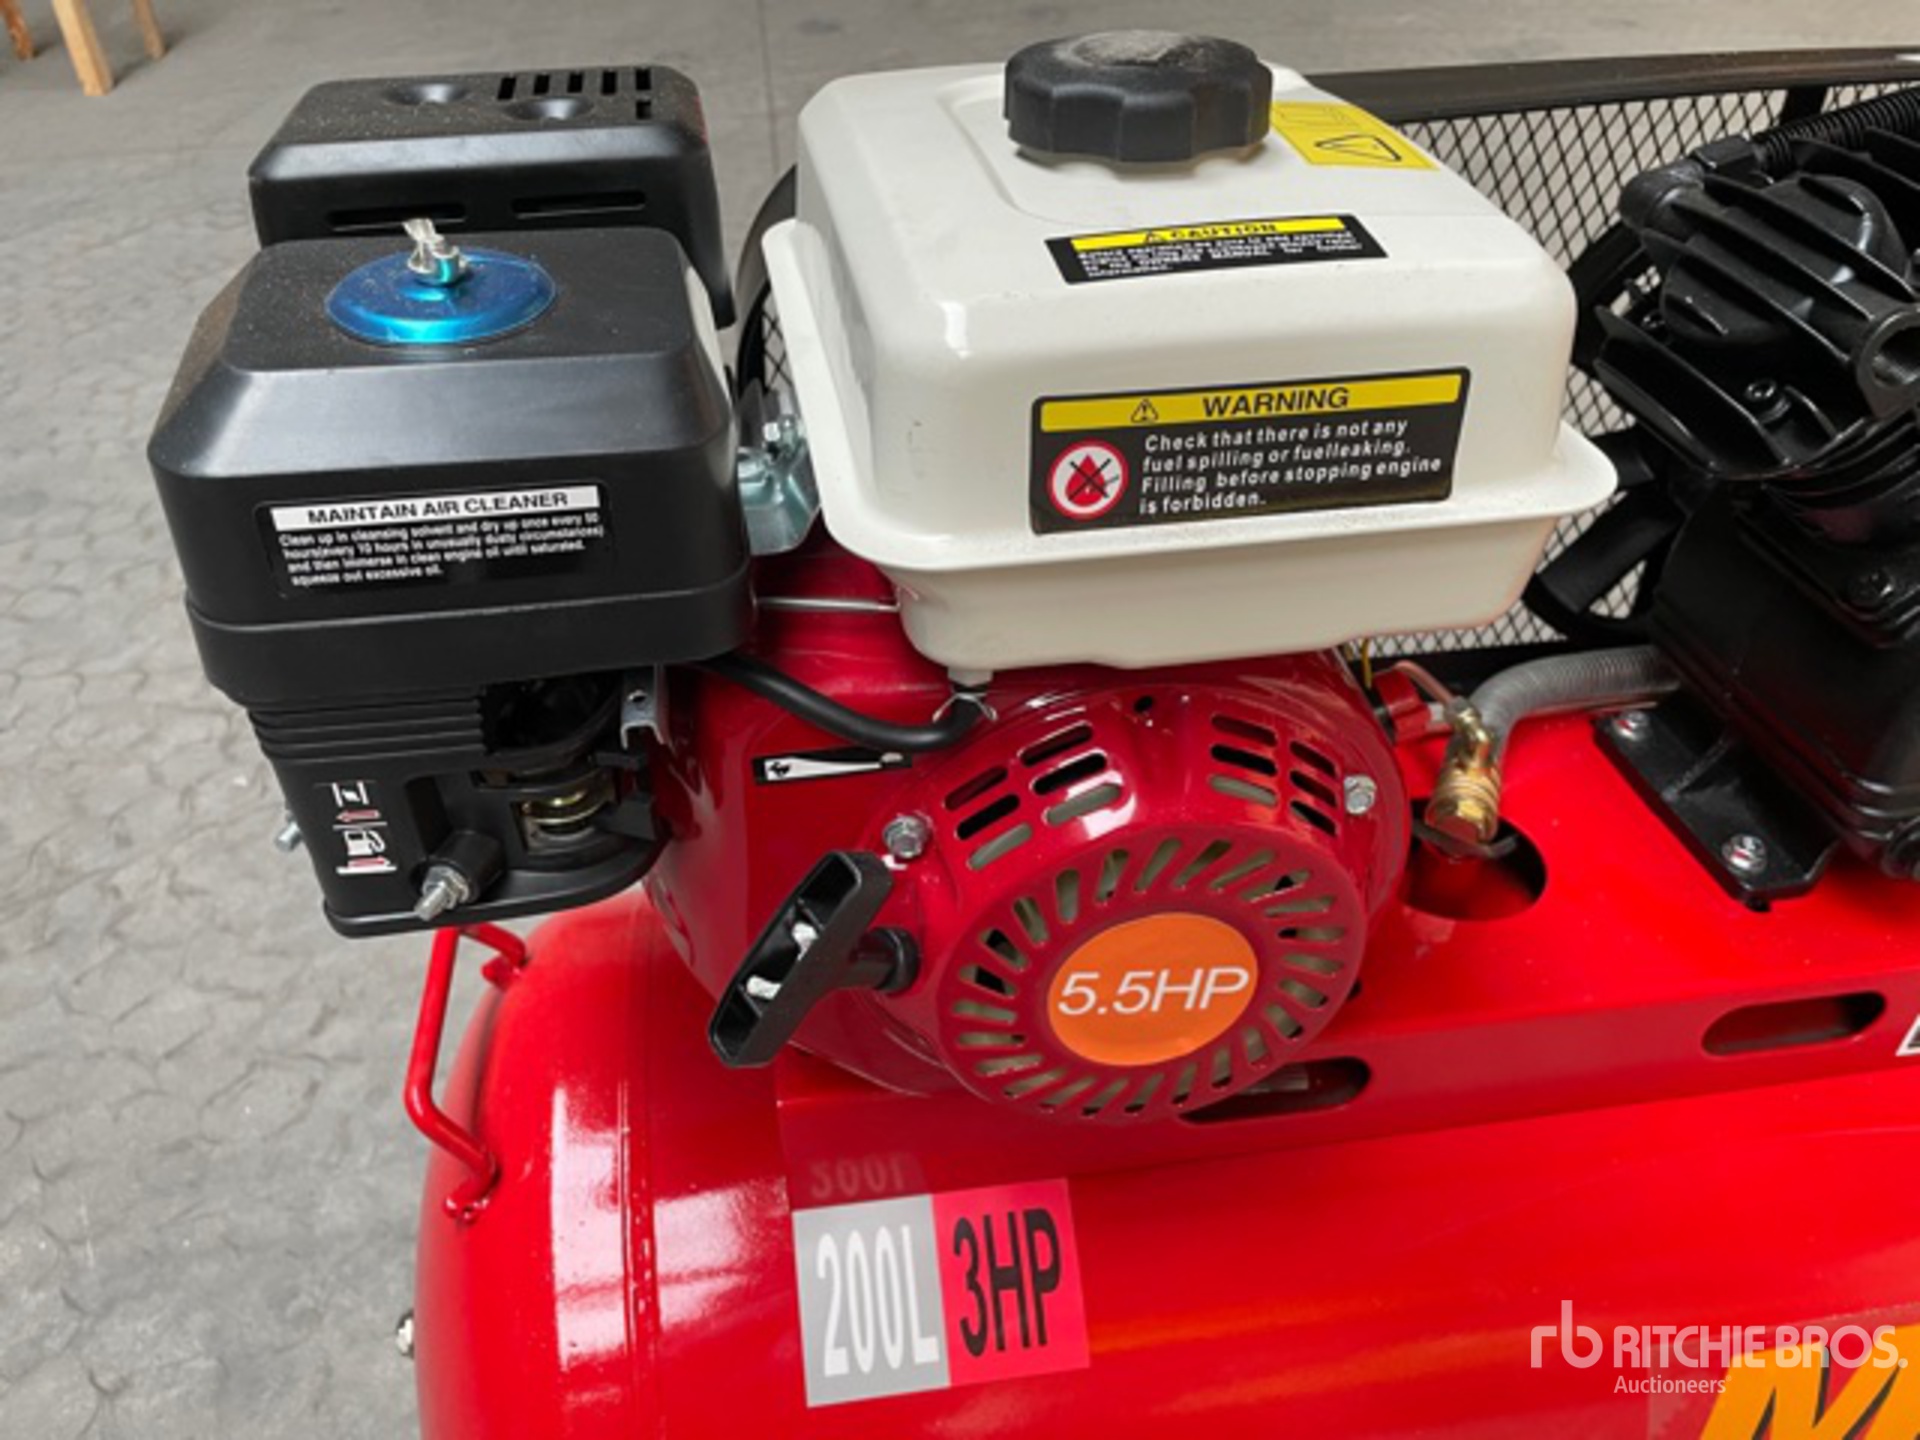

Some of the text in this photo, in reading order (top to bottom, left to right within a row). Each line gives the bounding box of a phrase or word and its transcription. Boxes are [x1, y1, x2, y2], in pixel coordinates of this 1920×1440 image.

[1202, 387, 1349, 418] WARNING
[1145, 419, 1408, 453] Check that there is not any
[1142, 454, 1183, 473] fuel
[1187, 449, 1264, 472] spilling
[1268, 448, 1290, 464] or
[1142, 456, 1442, 494] Filling before stopping engine
[308, 491, 569, 525] MAINTAIN AIR CLEANER
[1140, 491, 1267, 515] is forbidden.
[278, 533, 316, 547] Clean
[317, 532, 334, 546] up
[1057, 966, 1250, 1016] 5.5HP
[817, 1207, 1062, 1378] 200L 3HP
